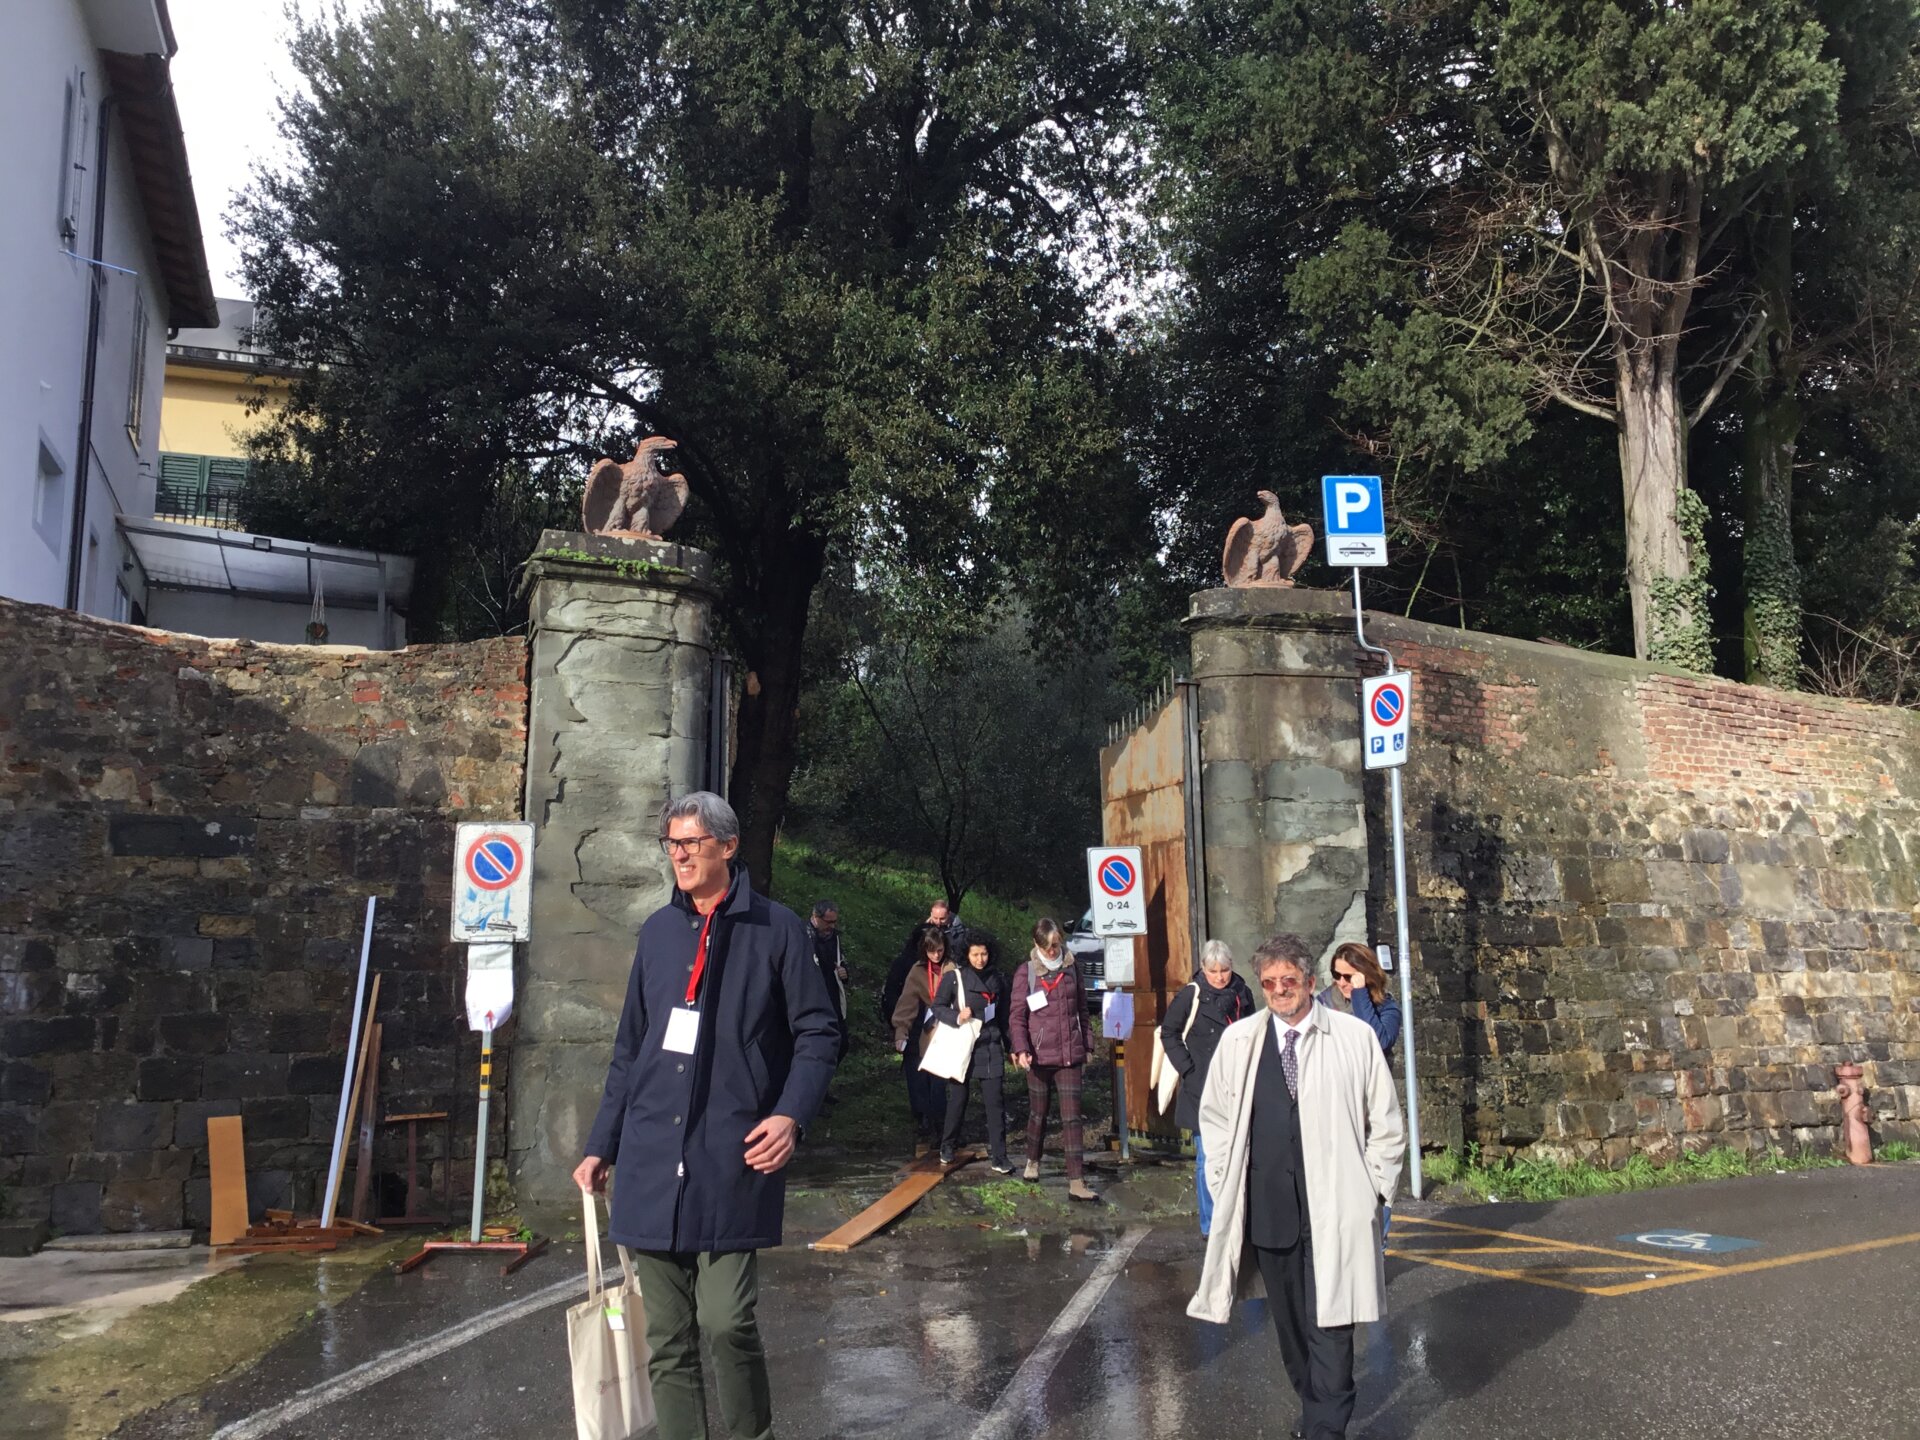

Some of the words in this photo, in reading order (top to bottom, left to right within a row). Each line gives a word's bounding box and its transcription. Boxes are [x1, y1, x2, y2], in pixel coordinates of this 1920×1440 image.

[1335, 482, 1370, 528] P
[1373, 738, 1382, 752] P
[1106, 901, 1130, 910] 0-24
